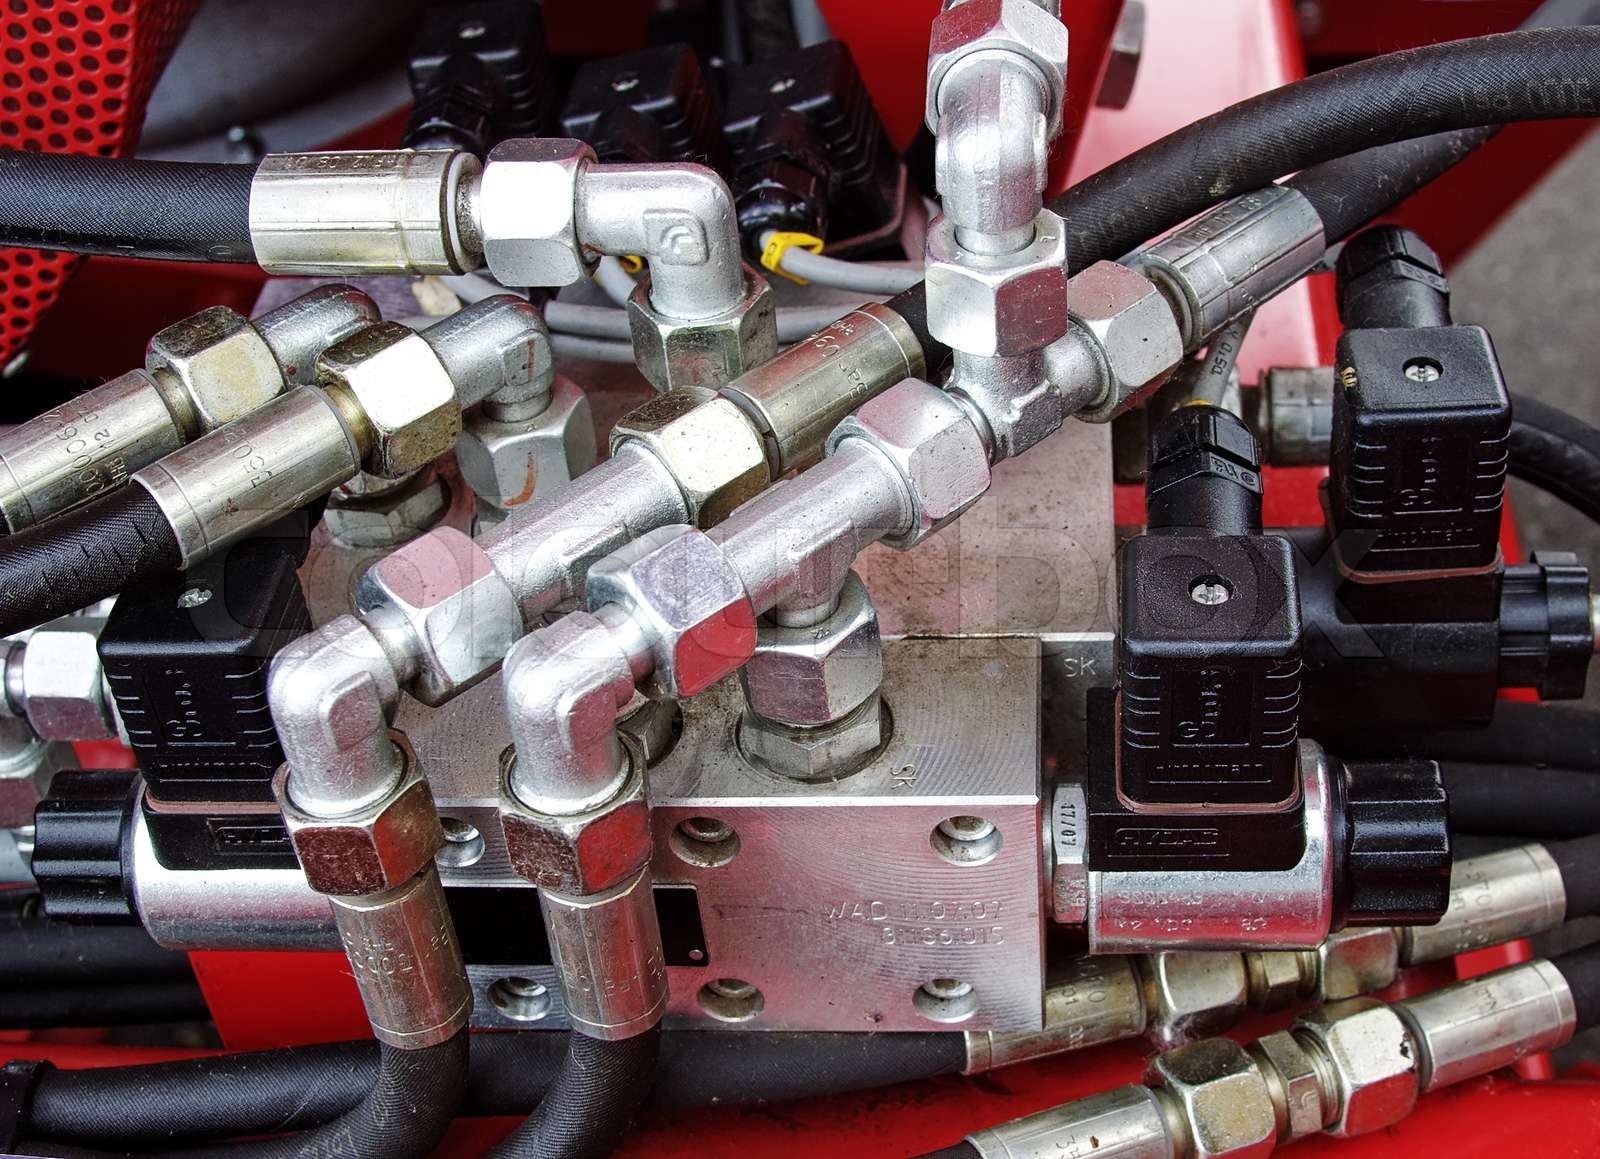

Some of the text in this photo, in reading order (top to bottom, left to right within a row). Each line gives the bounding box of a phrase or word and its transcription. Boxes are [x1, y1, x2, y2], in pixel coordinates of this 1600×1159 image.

[1063, 656, 1096, 678] SK
[890, 764, 918, 792] SK
[1063, 802, 1077, 848] 17/07
